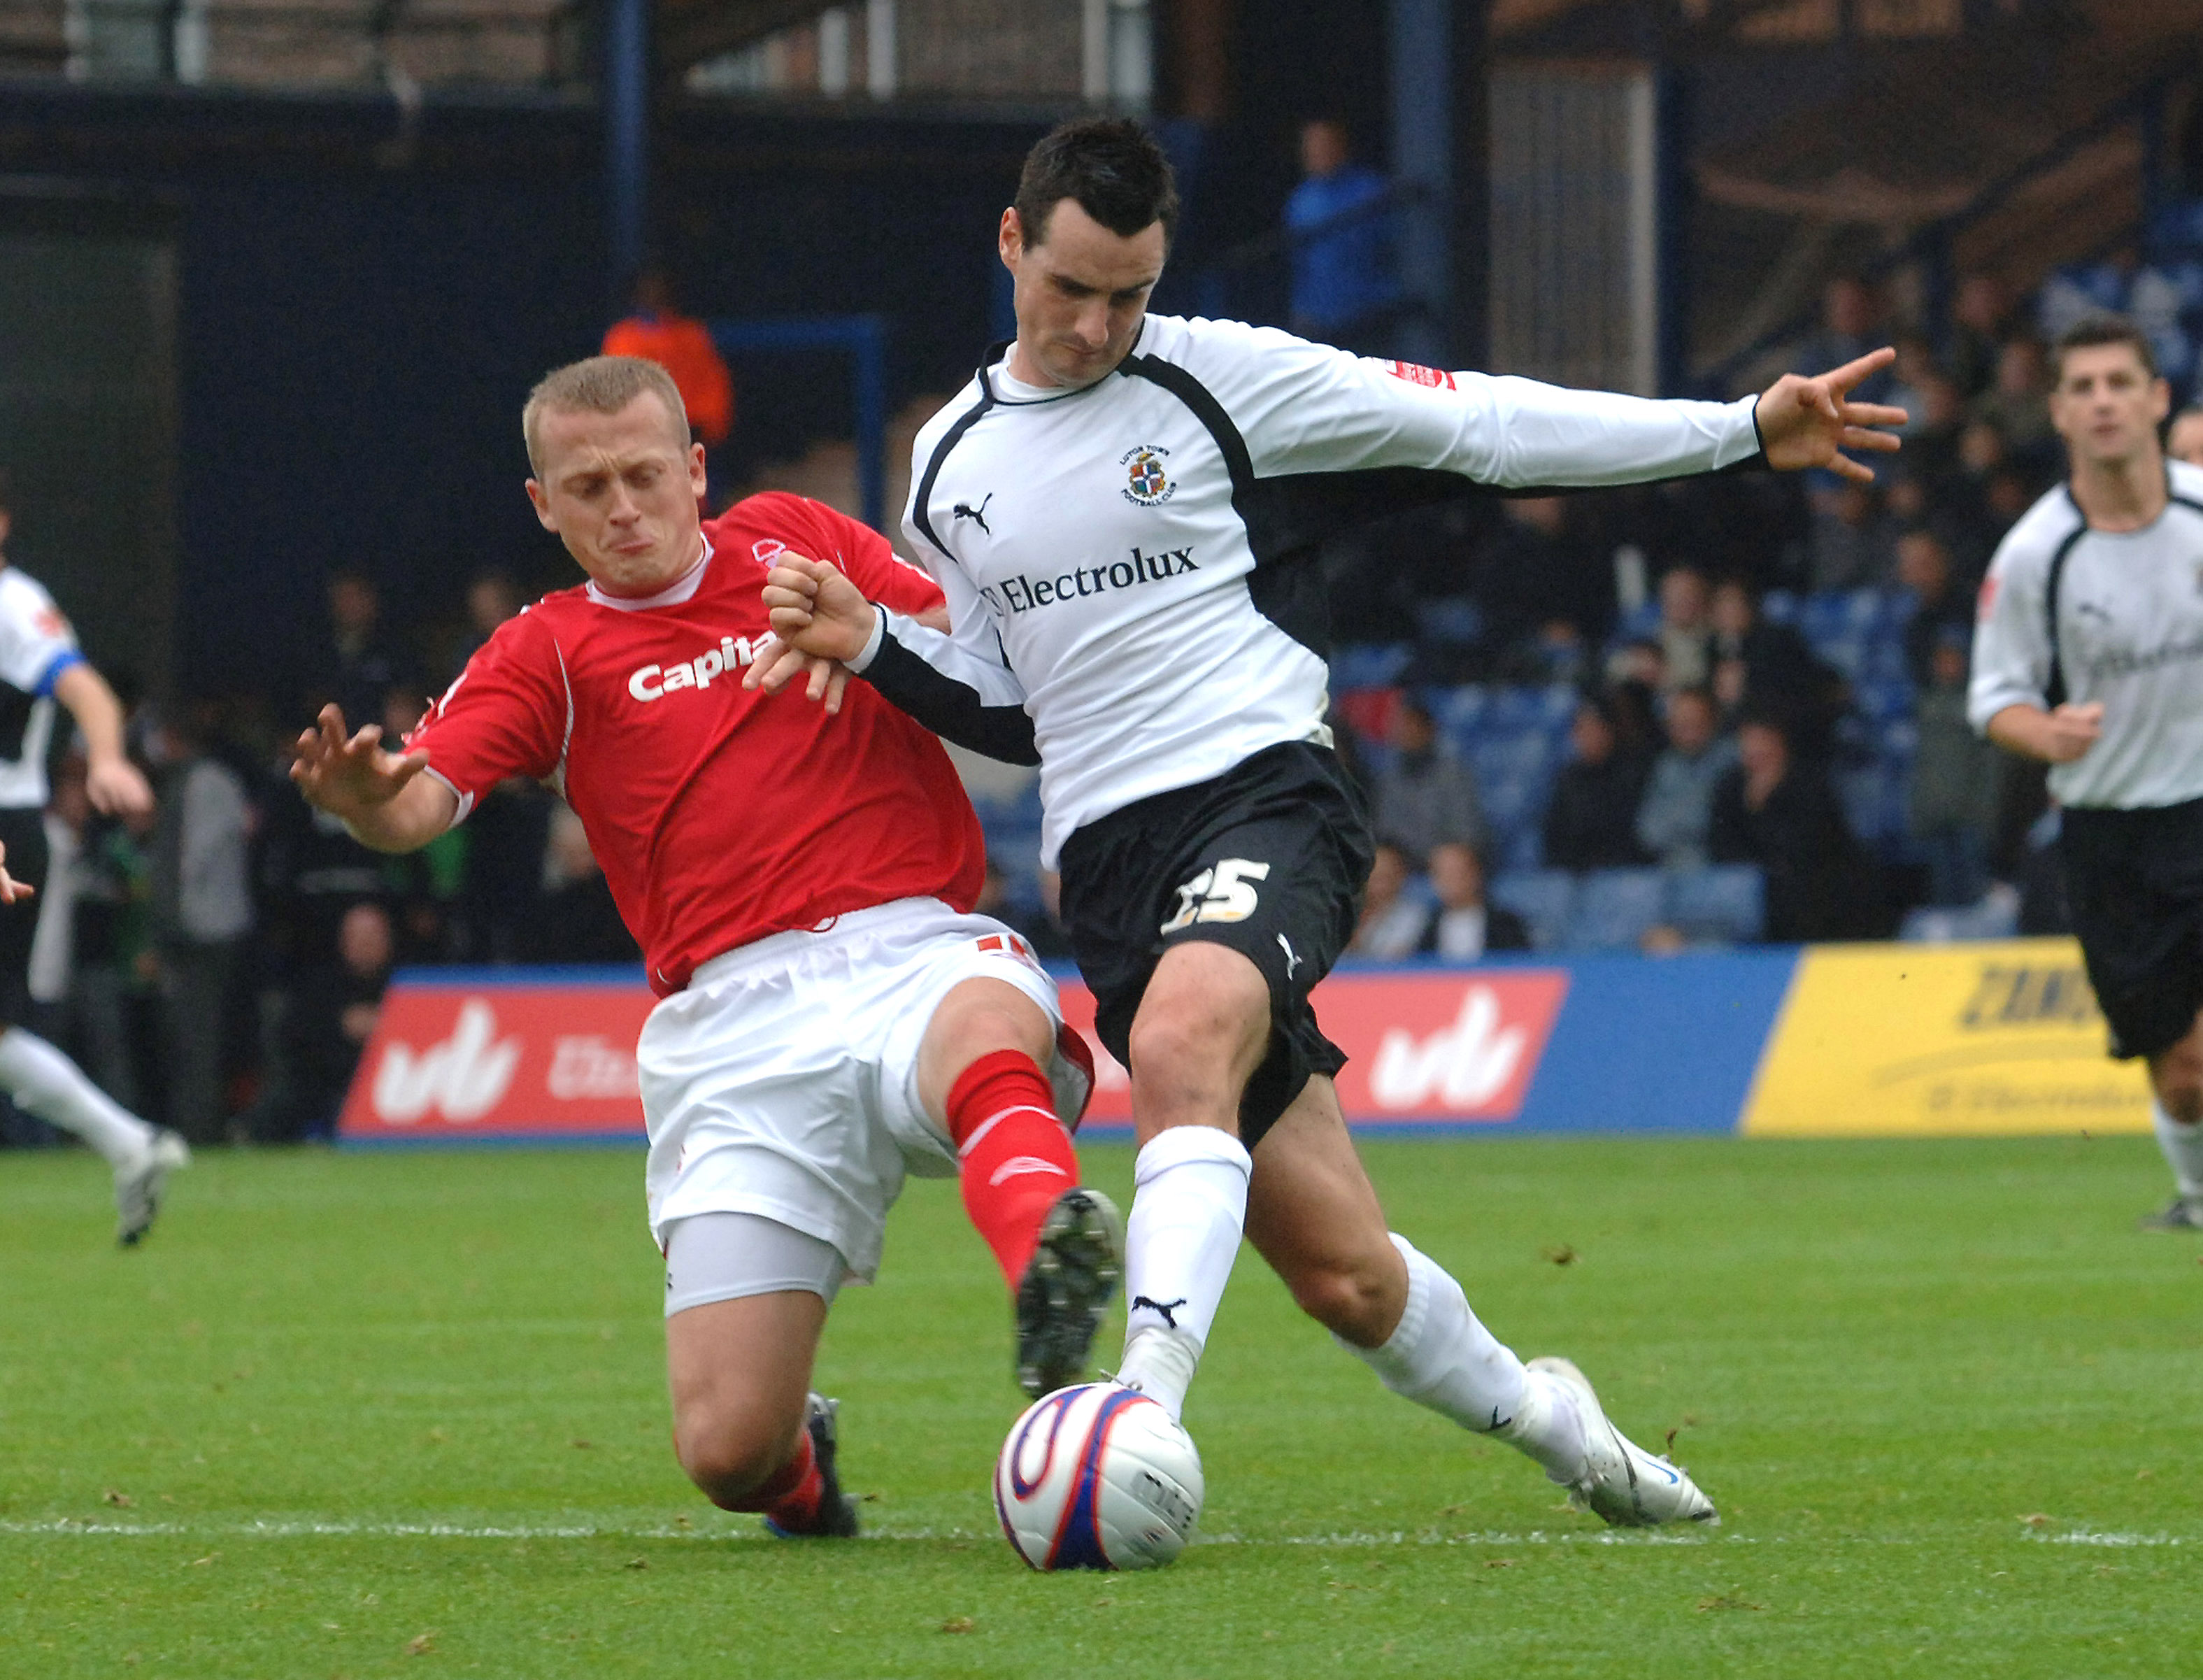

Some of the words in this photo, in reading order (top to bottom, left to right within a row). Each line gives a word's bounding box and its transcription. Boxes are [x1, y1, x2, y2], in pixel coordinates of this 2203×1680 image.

[1119, 446, 1143, 465] LUTON
[1146, 444, 1170, 457] TOWN
[1120, 487, 1162, 506] FOOTBALL
[1162, 481, 1176, 501] CLUB
[999, 546, 1201, 613] Electrolux
